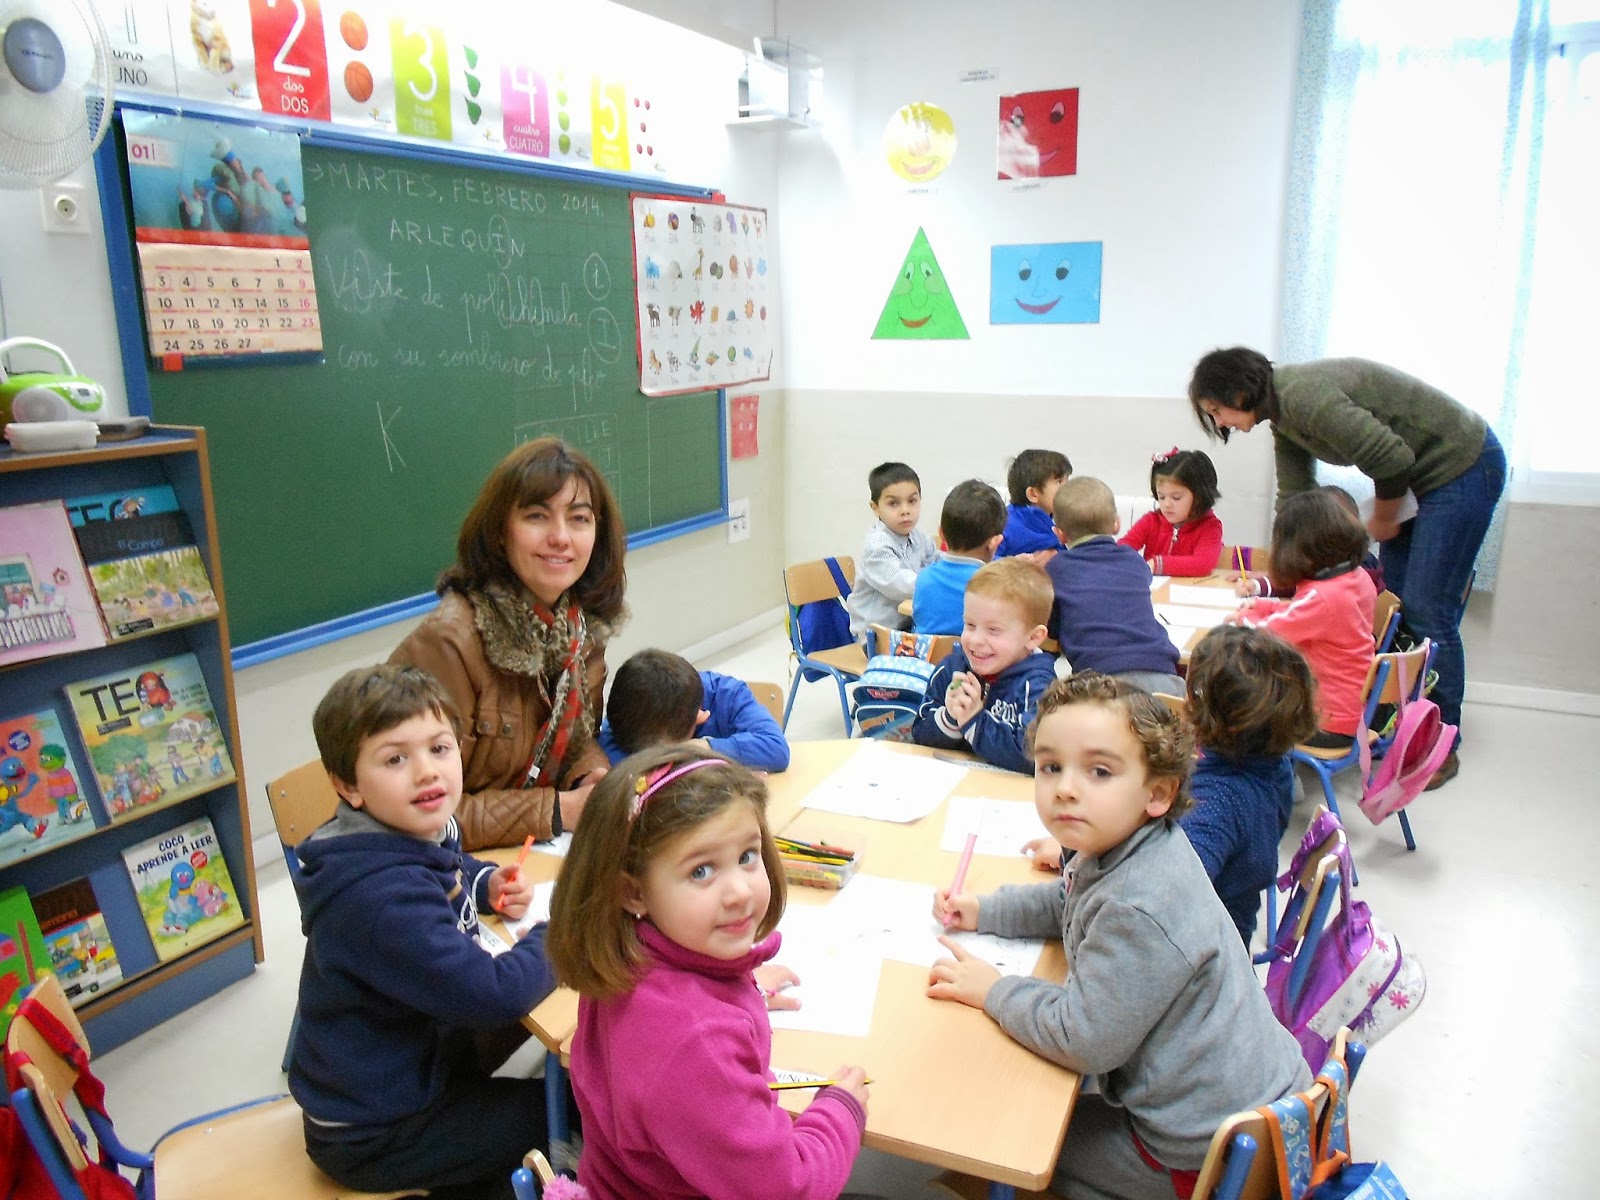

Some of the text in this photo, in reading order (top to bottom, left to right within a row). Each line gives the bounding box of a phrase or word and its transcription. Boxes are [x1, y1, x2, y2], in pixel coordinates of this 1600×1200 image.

[267, 0, 311, 78] 2
[112, 49, 144, 62] uno
[403, 23, 438, 101] 3
[283, 74, 305, 94] dos
[509, 63, 538, 124] 4
[281, 94, 310, 115] DOS
[599, 79, 621, 141] 5
[513, 124, 541, 138] cuatro
[507, 135, 544, 153] CUATRO
[452, 177, 547, 213] FEBRERO
[275, 258, 303, 269] 1 2
[158, 276, 166, 287] 3
[182, 276, 190, 288] 4
[207, 277, 215, 288] 5
[231, 277, 239, 288] 6
[255, 278, 262, 289] 7
[277, 278, 285, 289] 8
[158, 297, 311, 309] 10 11 12 13 14 15 16
[162, 317, 314, 331] 17 18 19 20 21 22 23
[163, 340, 180, 351] 24
[190, 339, 205, 350] 25
[213, 338, 229, 350] 26
[238, 338, 251, 349] 27
[377, 401, 407, 474] K
[159, 834, 185, 852] COCO
[137, 849, 180, 875] APRENDE
[182, 845, 189, 856] A
[190, 834, 213, 851] LEER
